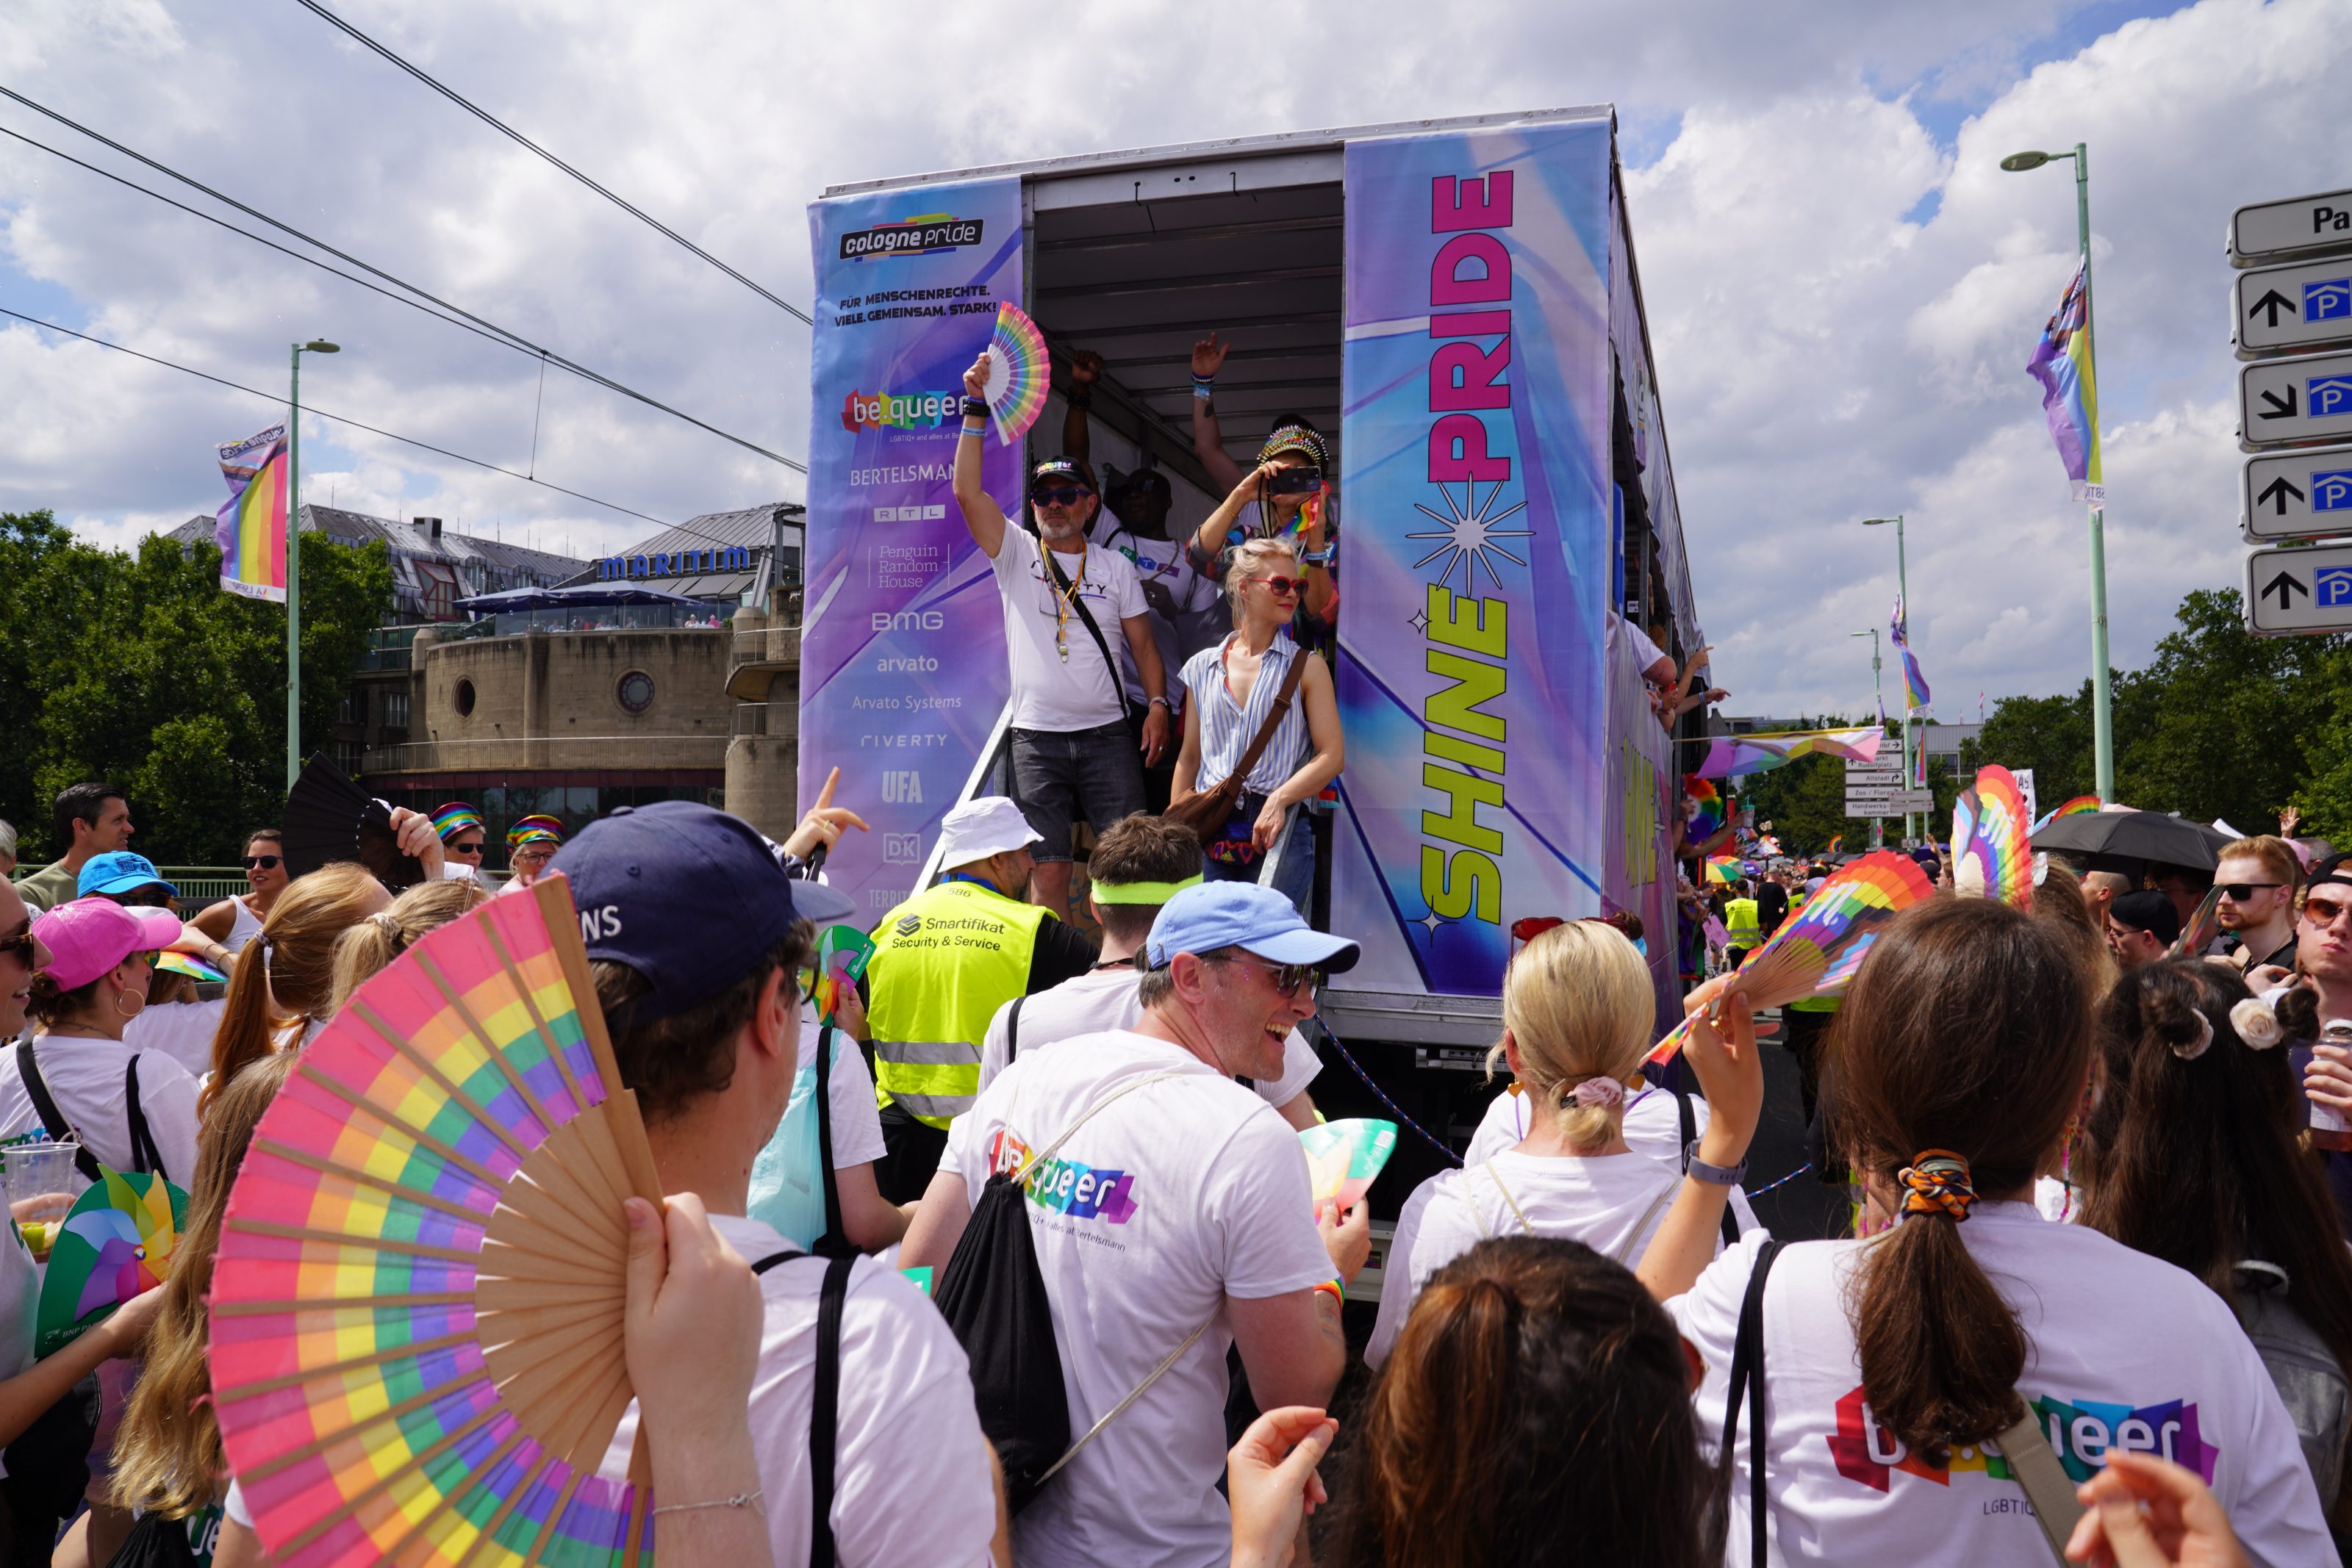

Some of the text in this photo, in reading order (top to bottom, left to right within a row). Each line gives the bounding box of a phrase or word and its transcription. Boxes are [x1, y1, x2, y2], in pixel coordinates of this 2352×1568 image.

[2313, 206, 2351, 234] Pa
[845, 223, 976, 254] cologne pride
[839, 284, 990, 310] FÜR MENSCHENRECHTE.
[835, 301, 997, 327] VIELE. GEMEINSAM. STARK!
[1428, 170, 1513, 483] PRIDE
[853, 395, 970, 426] be.queer
[928, 433, 943, 441] allies
[877, 506, 942, 521] RTL
[878, 545, 939, 561] Penguin
[602, 546, 750, 580] MARITIM
[878, 561, 939, 574] Random
[878, 575, 924, 589] House
[872, 611, 944, 631] BMG
[877, 655, 939, 672] arvato
[852, 695, 961, 713] Arvato Systems
[861, 735, 948, 747] RIVERTY
[1419, 583, 1508, 926] SHINE
[882, 771, 923, 802] UFA
[888, 841, 915, 857] DK
[947, 887, 972, 898] 586
[579, 905, 623, 943] NS
[926, 917, 1005, 935] Smartifikat
[892, 935, 1001, 952] Security & Service
[1066, 1226, 1075, 1236] at
[62, 1326, 80, 1338] BNP
